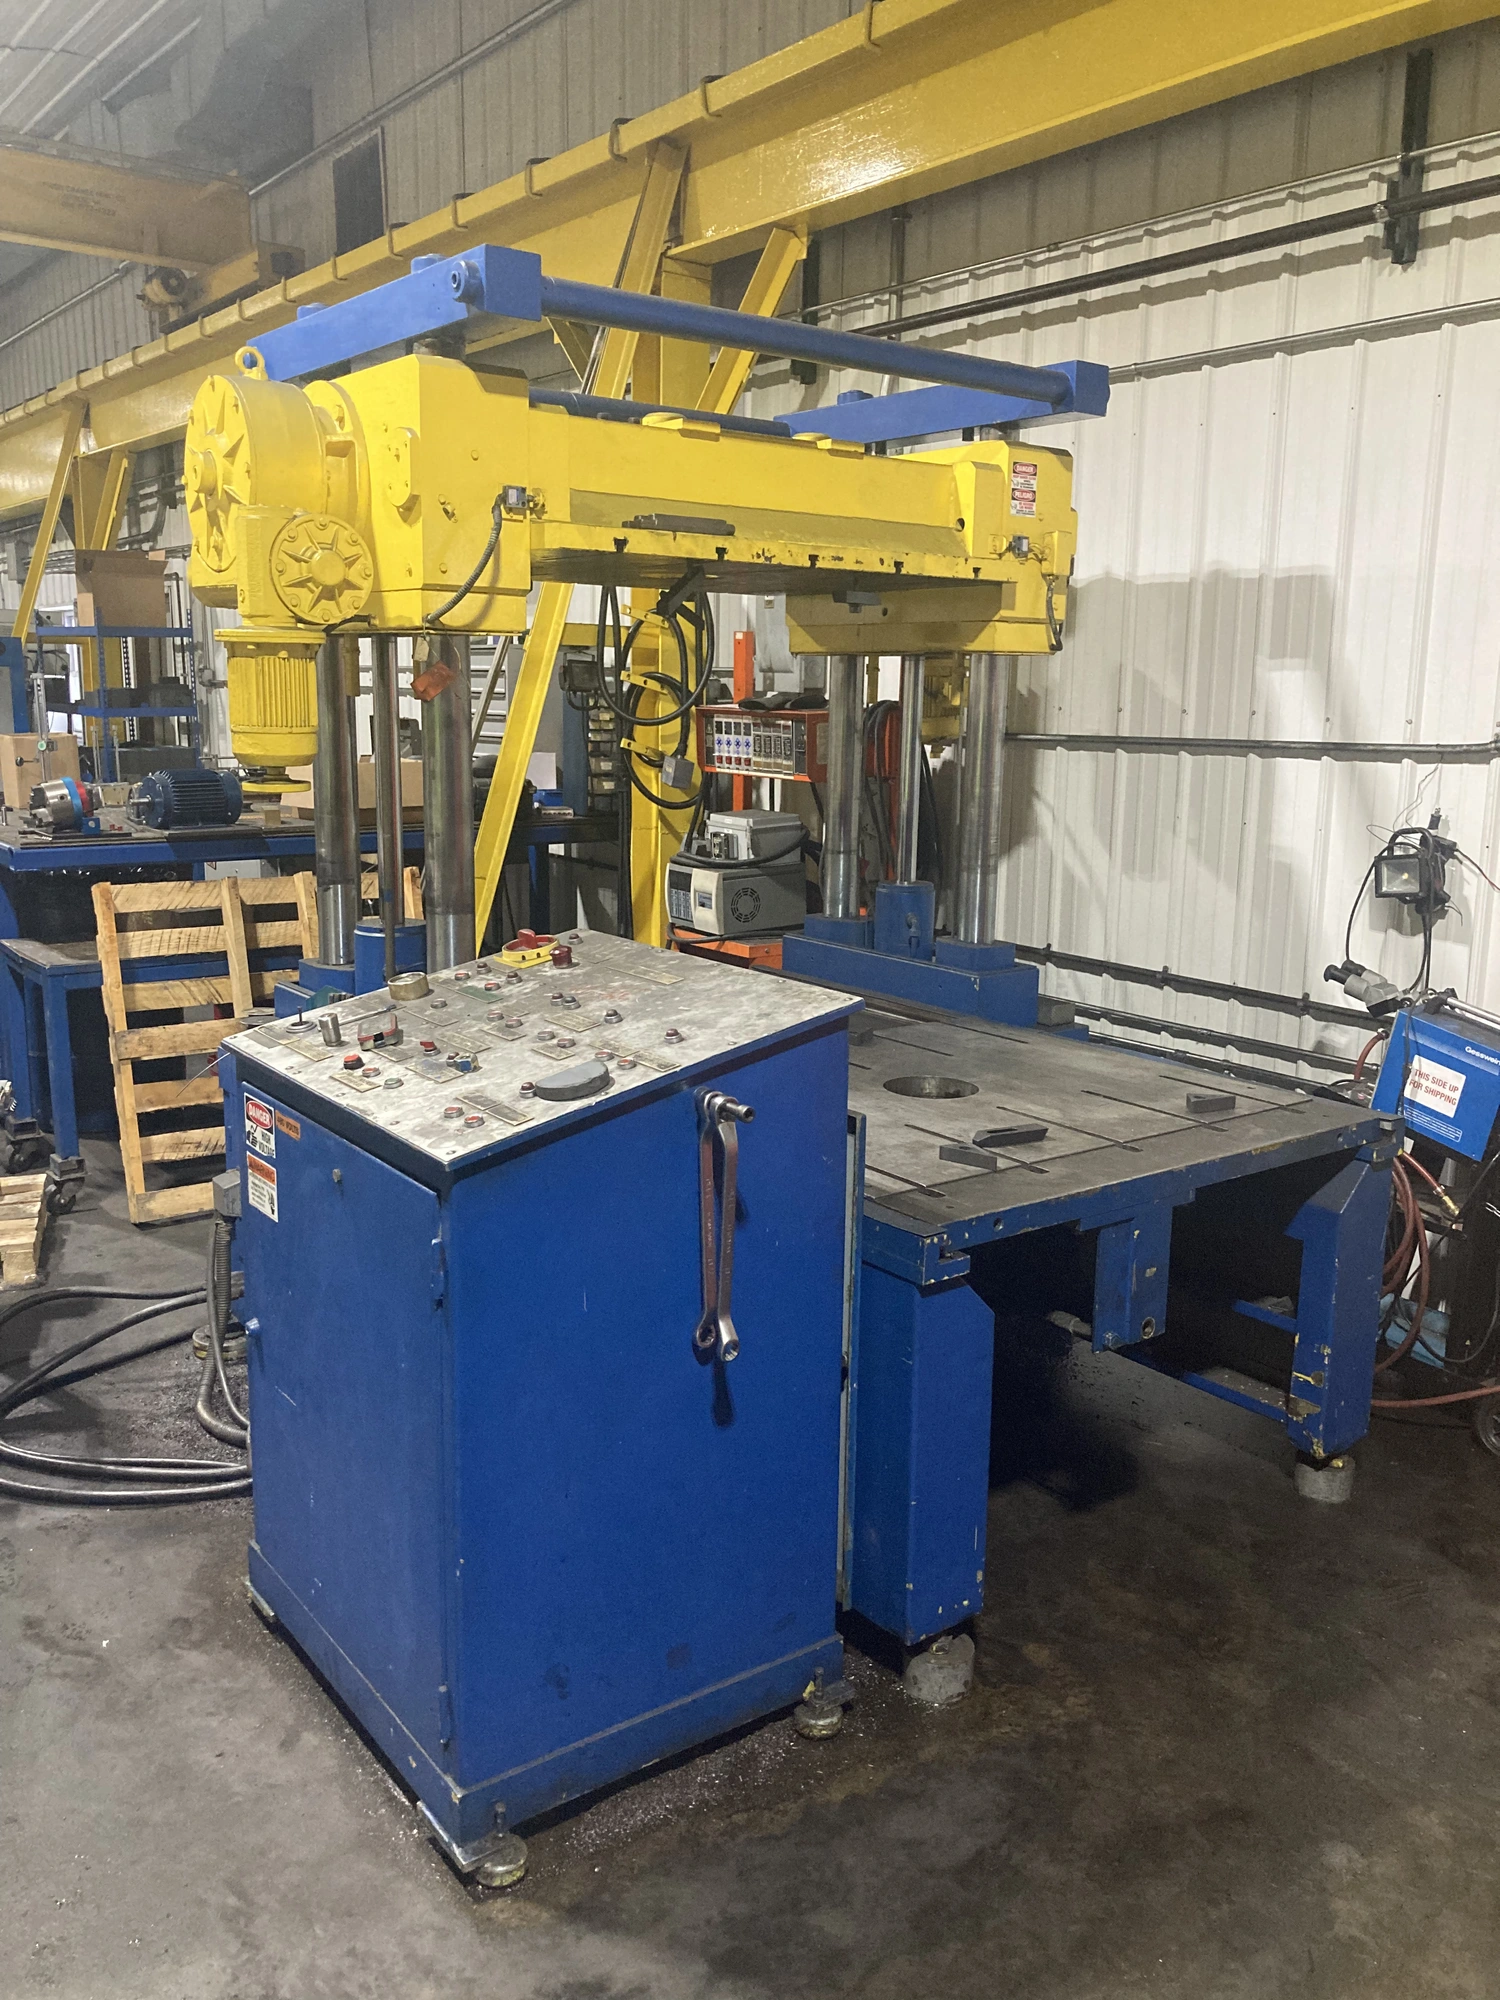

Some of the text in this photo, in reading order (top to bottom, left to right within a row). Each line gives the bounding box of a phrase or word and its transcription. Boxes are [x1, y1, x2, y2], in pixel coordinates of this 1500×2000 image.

[1016, 465, 1034, 473] DANGER
[1015, 491, 1033, 499] PELIGRO
[1414, 1069, 1459, 1094] THIS SIDE UP
[1409, 1079, 1457, 1106] FOR SHIPPING
[248, 1103, 271, 1126] DANGER
[261, 1130, 272, 1146] HIGH
[258, 1140, 275, 1157] VOLTAGE
